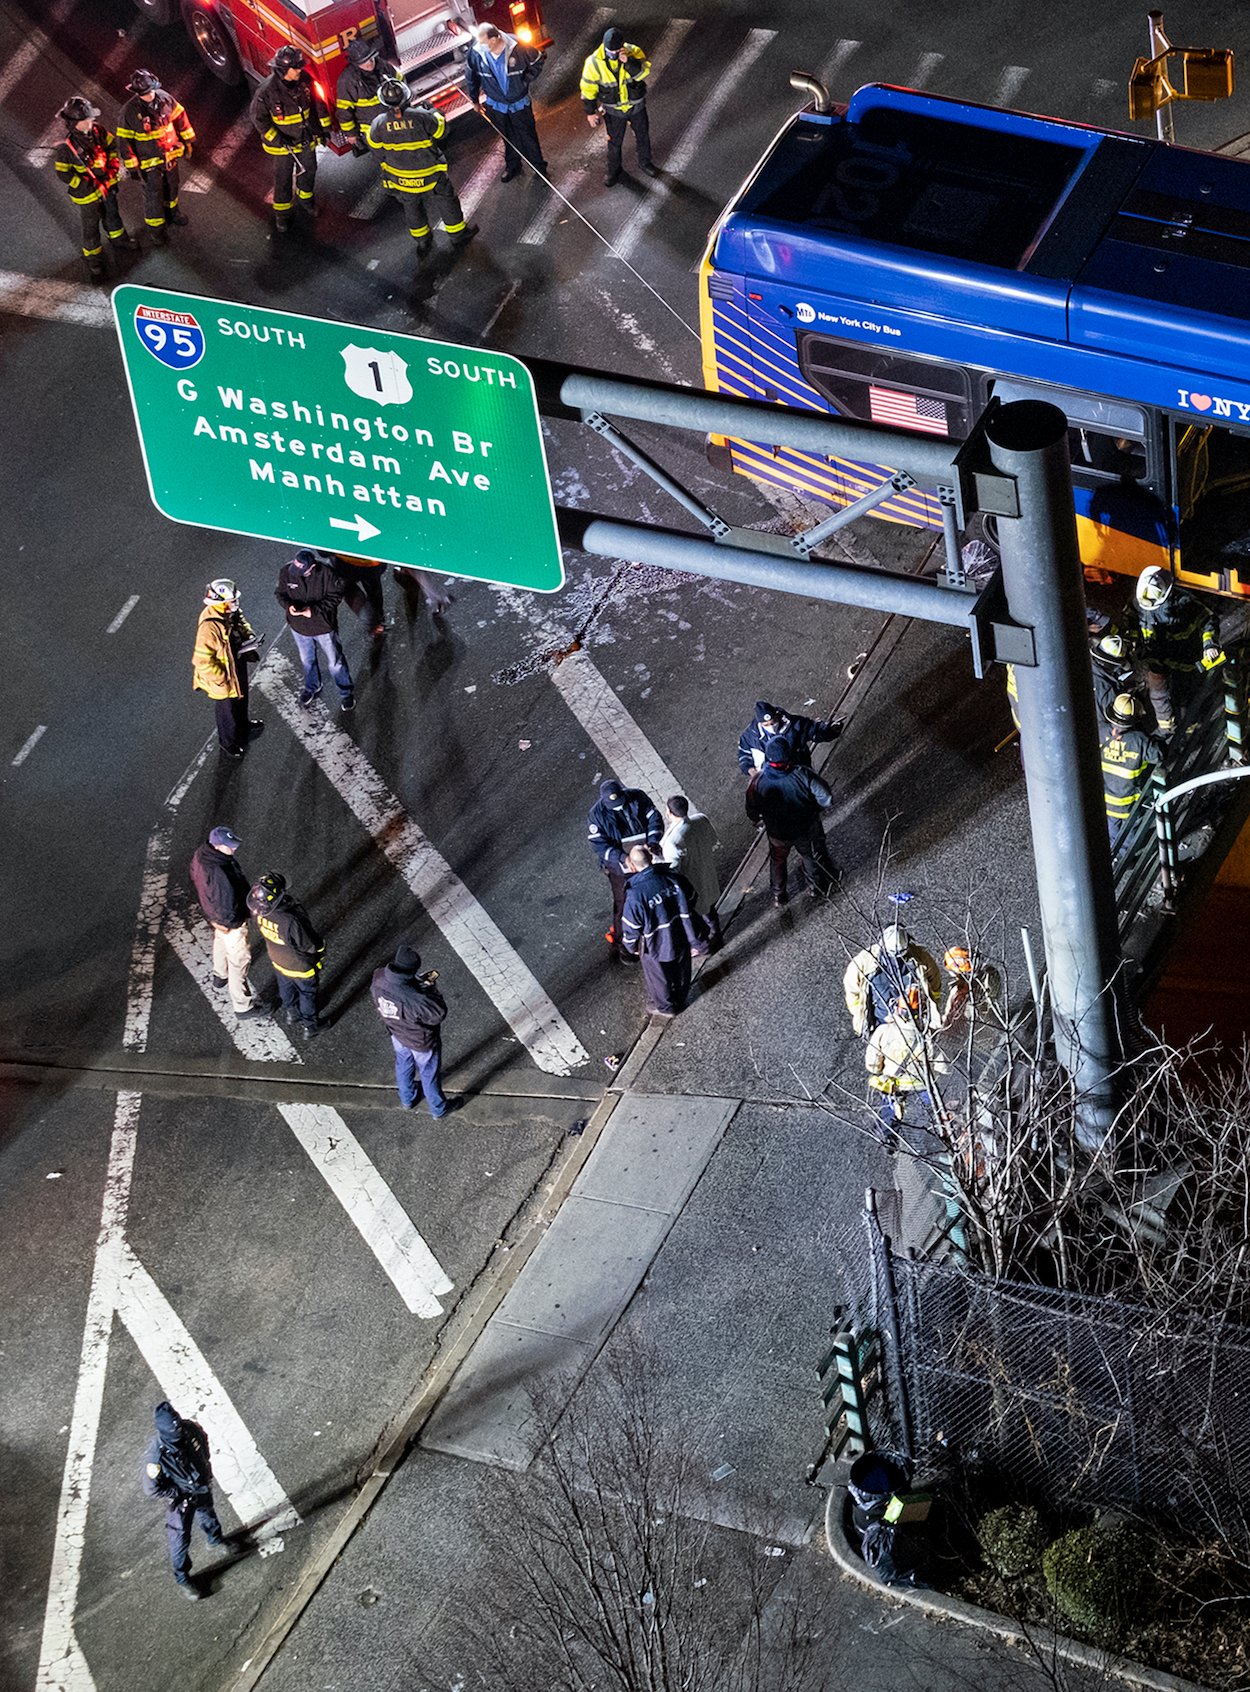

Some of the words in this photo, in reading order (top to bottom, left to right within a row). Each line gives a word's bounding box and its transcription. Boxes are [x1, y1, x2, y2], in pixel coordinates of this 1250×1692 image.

[398, 177, 425, 187] CONROY
[142, 308, 191, 325] INTERSTATE
[818, 311, 839, 323] New
[840, 316, 861, 328] York
[862, 321, 881, 333] City
[883, 325, 902, 336] Bus
[144, 324, 196, 357] 95
[217, 317, 306, 350] SOUTH
[368, 361, 383, 393] 1
[427, 357, 517, 389] SOUTH
[1177, 389, 1189, 408] I
[176, 379, 198, 401] G
[217, 385, 434, 447] Washington
[452, 430, 493, 457] Br
[193, 415, 401, 475] Amsterdam
[429, 461, 491, 491] Ave
[249, 458, 446, 516] Manhattan
